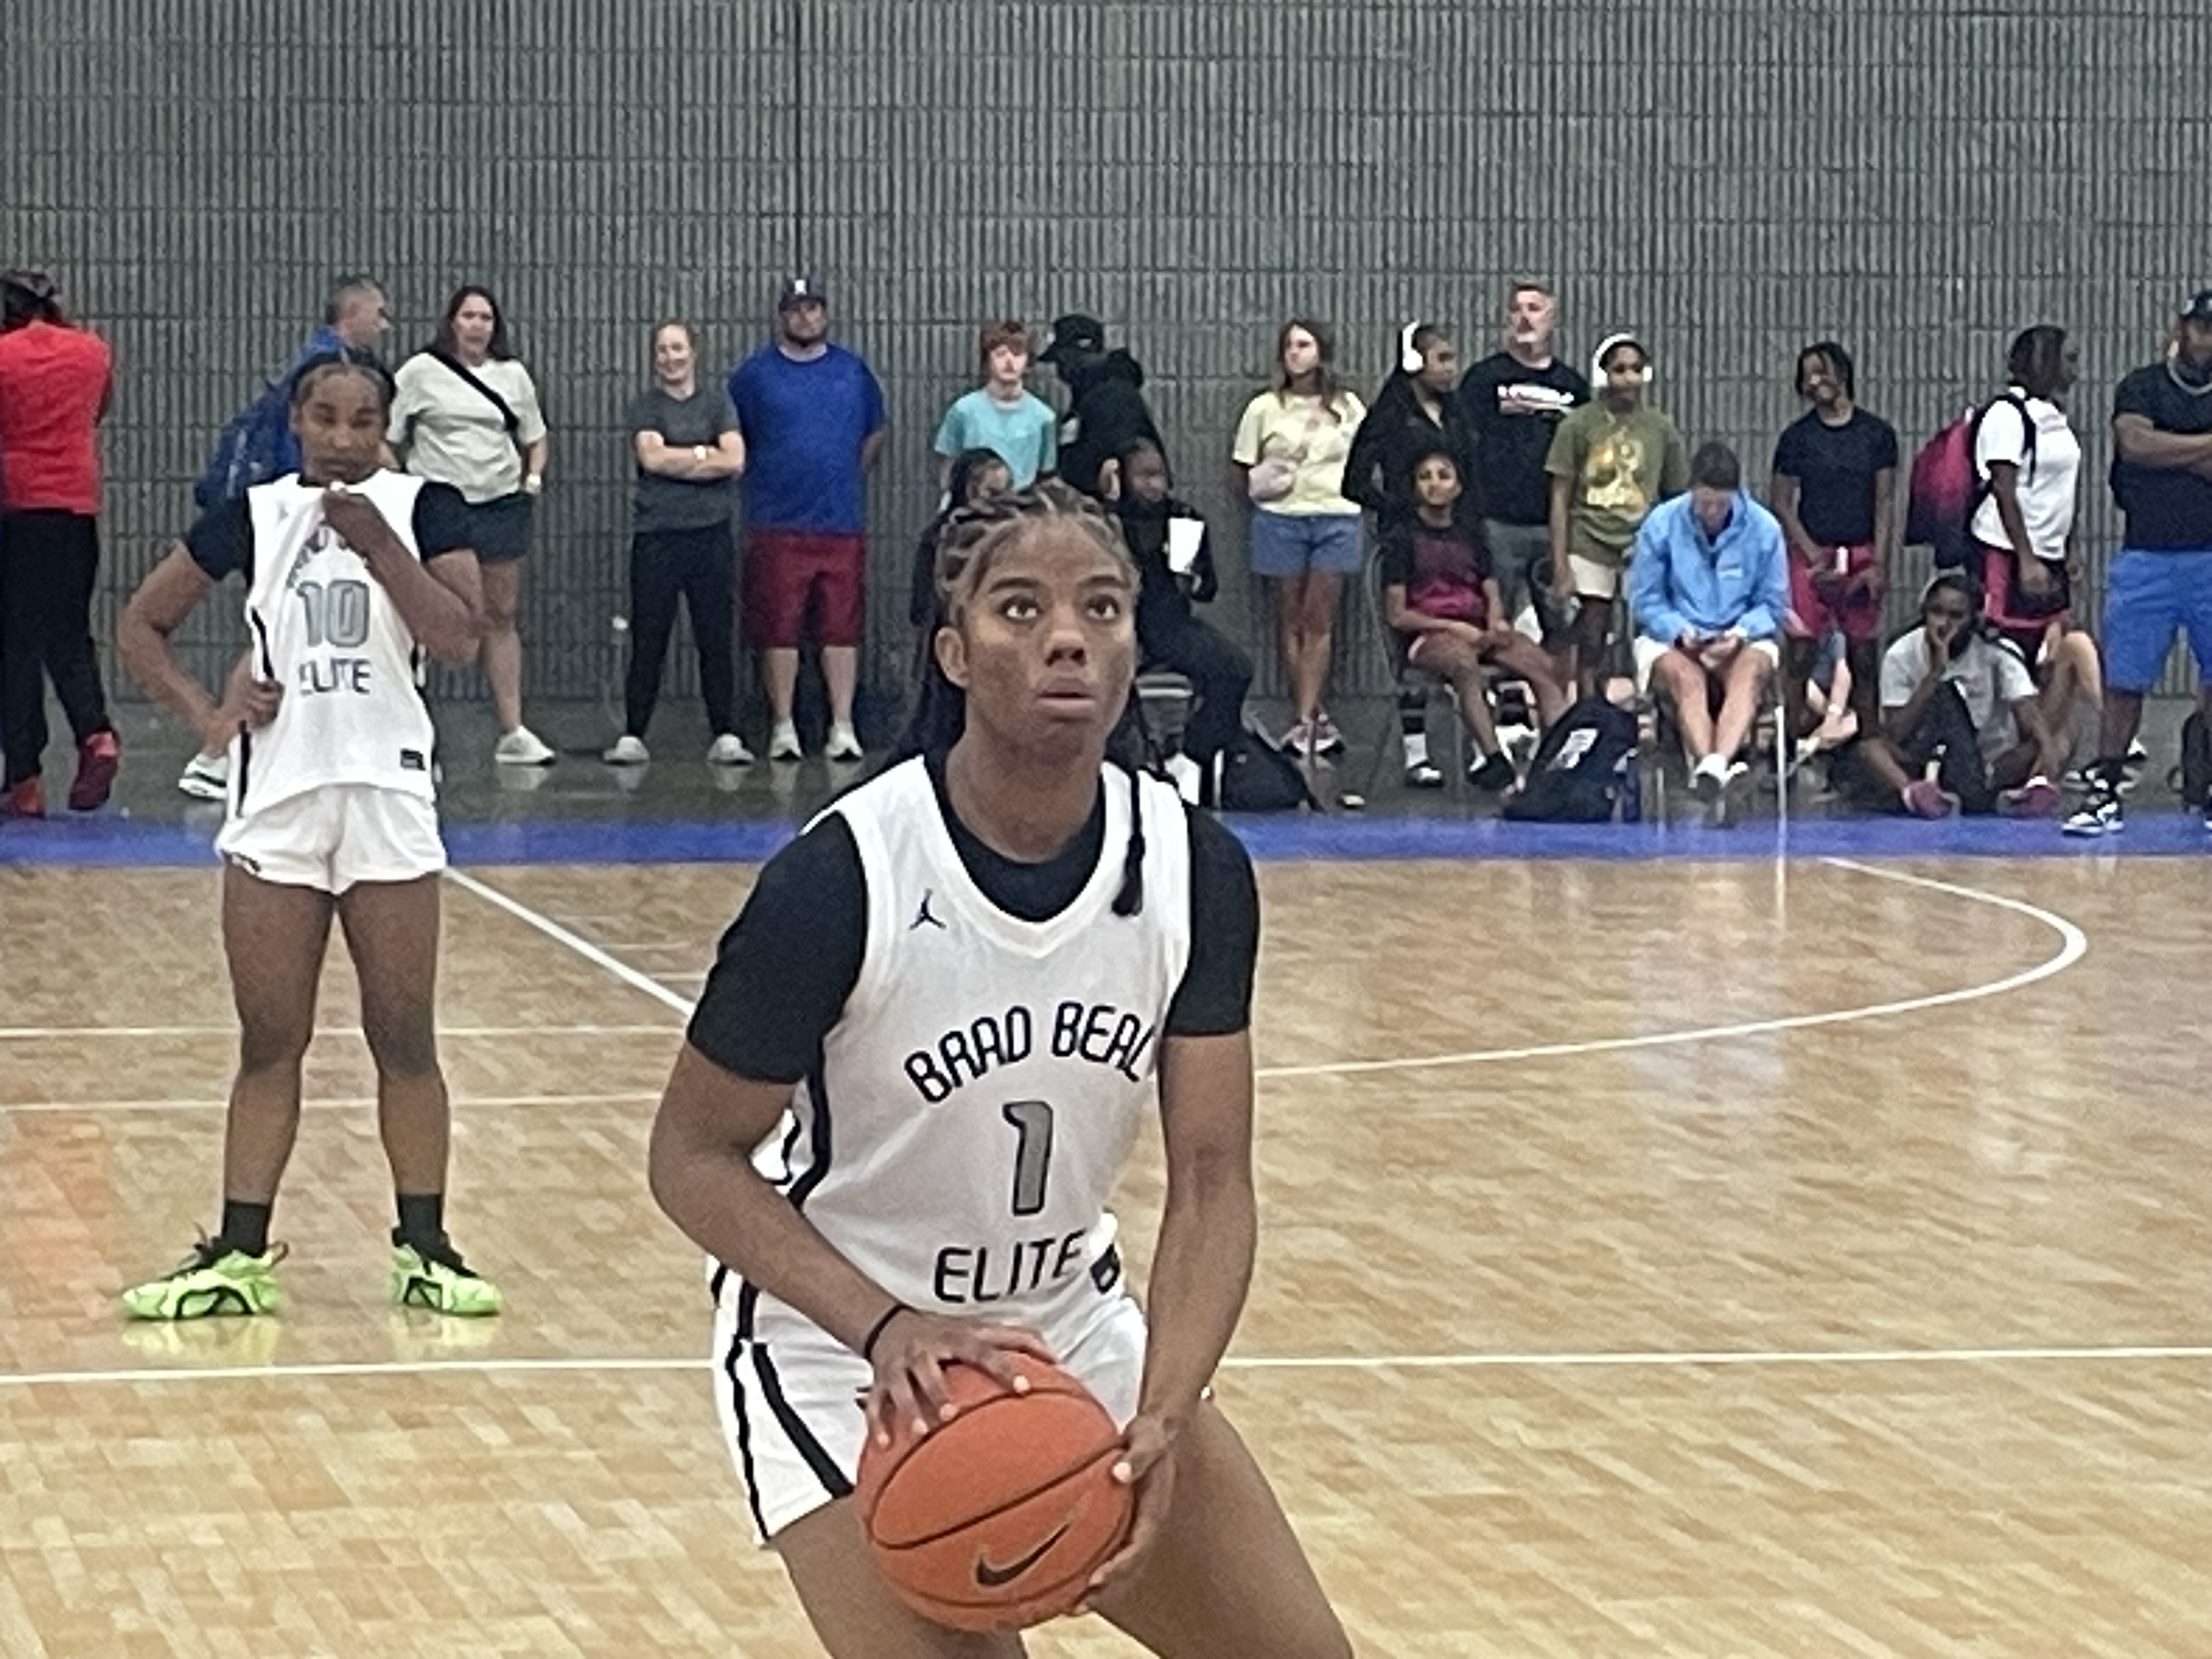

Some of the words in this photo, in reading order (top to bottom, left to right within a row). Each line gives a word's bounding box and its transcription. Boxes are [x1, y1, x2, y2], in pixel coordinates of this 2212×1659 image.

[297, 579, 369, 647] 10
[904, 1006, 1032, 1103] BRAD
[1051, 1001, 1155, 1082] BEAL
[1002, 1100, 1053, 1216] 1
[934, 1229, 1087, 1303] ELITE
